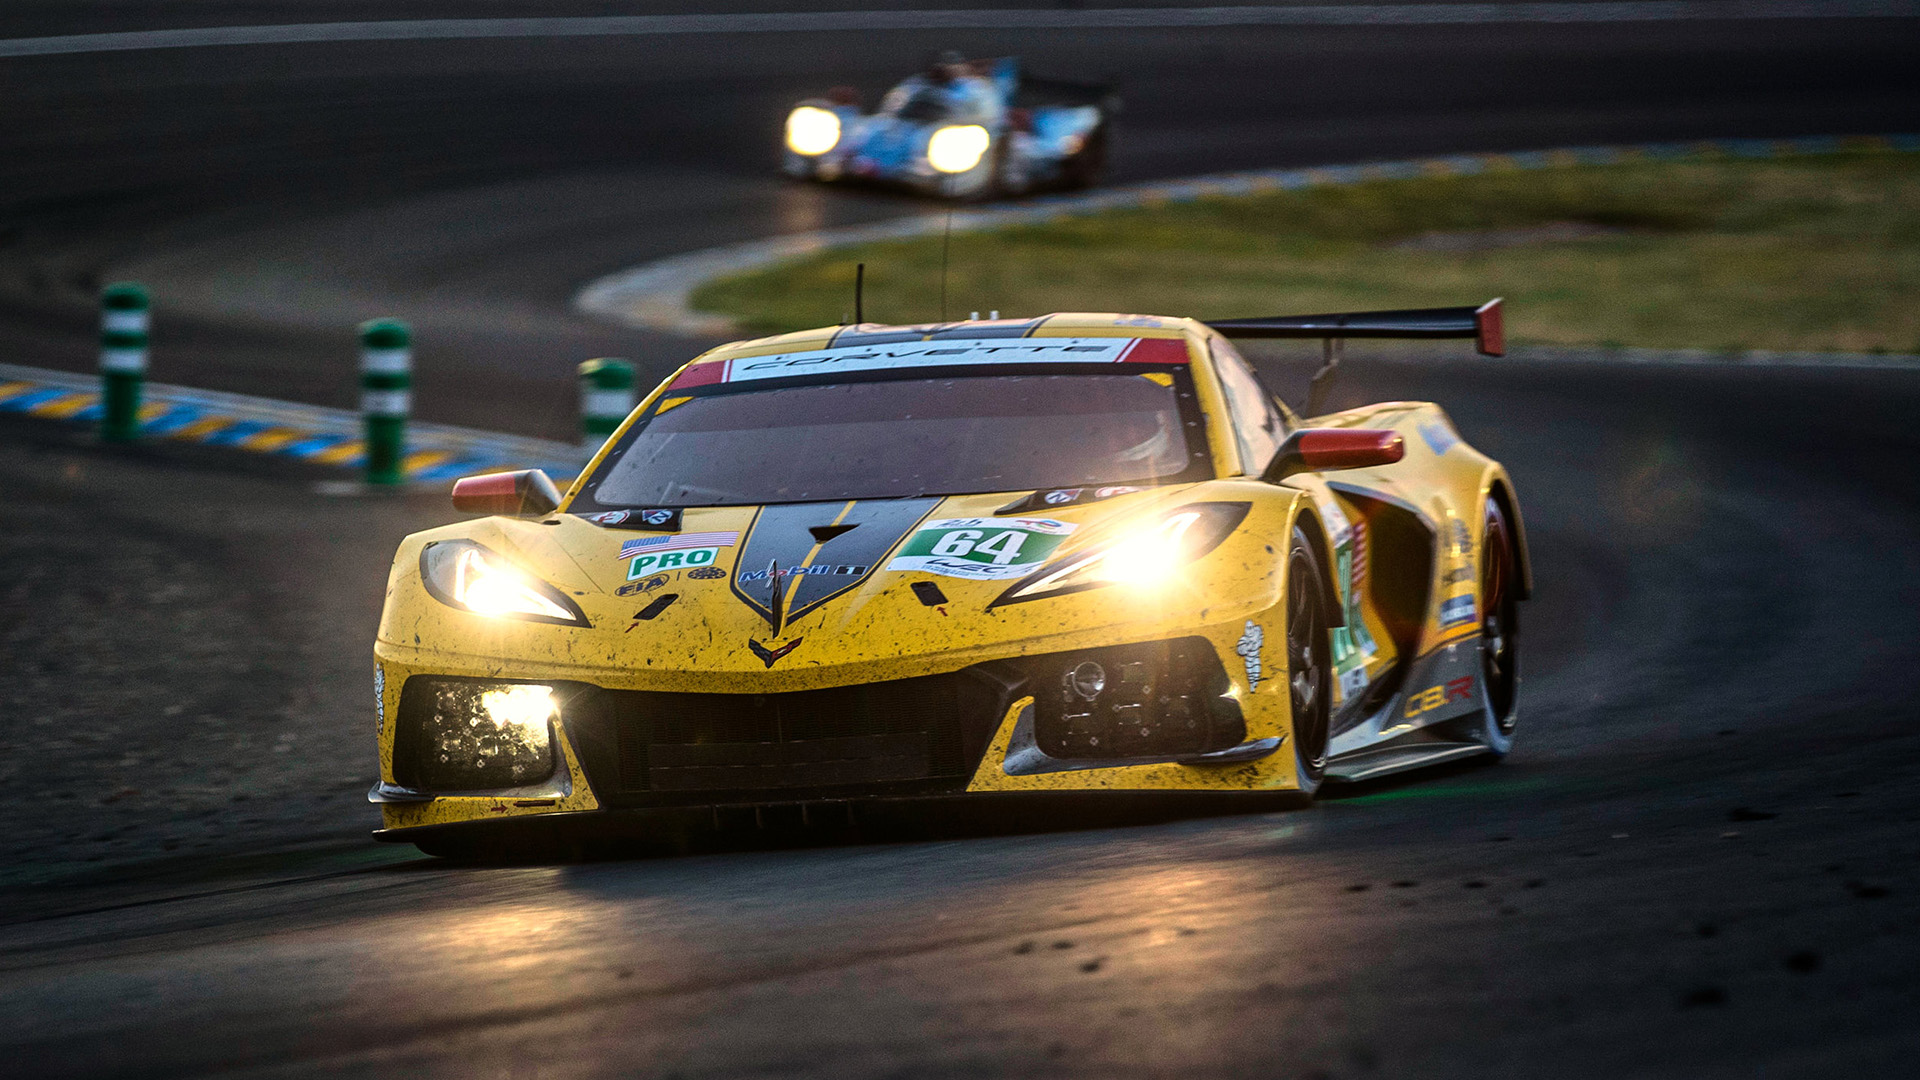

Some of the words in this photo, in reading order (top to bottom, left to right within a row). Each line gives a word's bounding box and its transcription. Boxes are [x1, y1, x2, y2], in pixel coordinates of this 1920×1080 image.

[743, 346, 1111, 371] CORVETTE
[930, 529, 1029, 565] 64
[631, 550, 712, 577] PRO
[738, 564, 830, 582] Mobil
[618, 577, 665, 596] FIA
